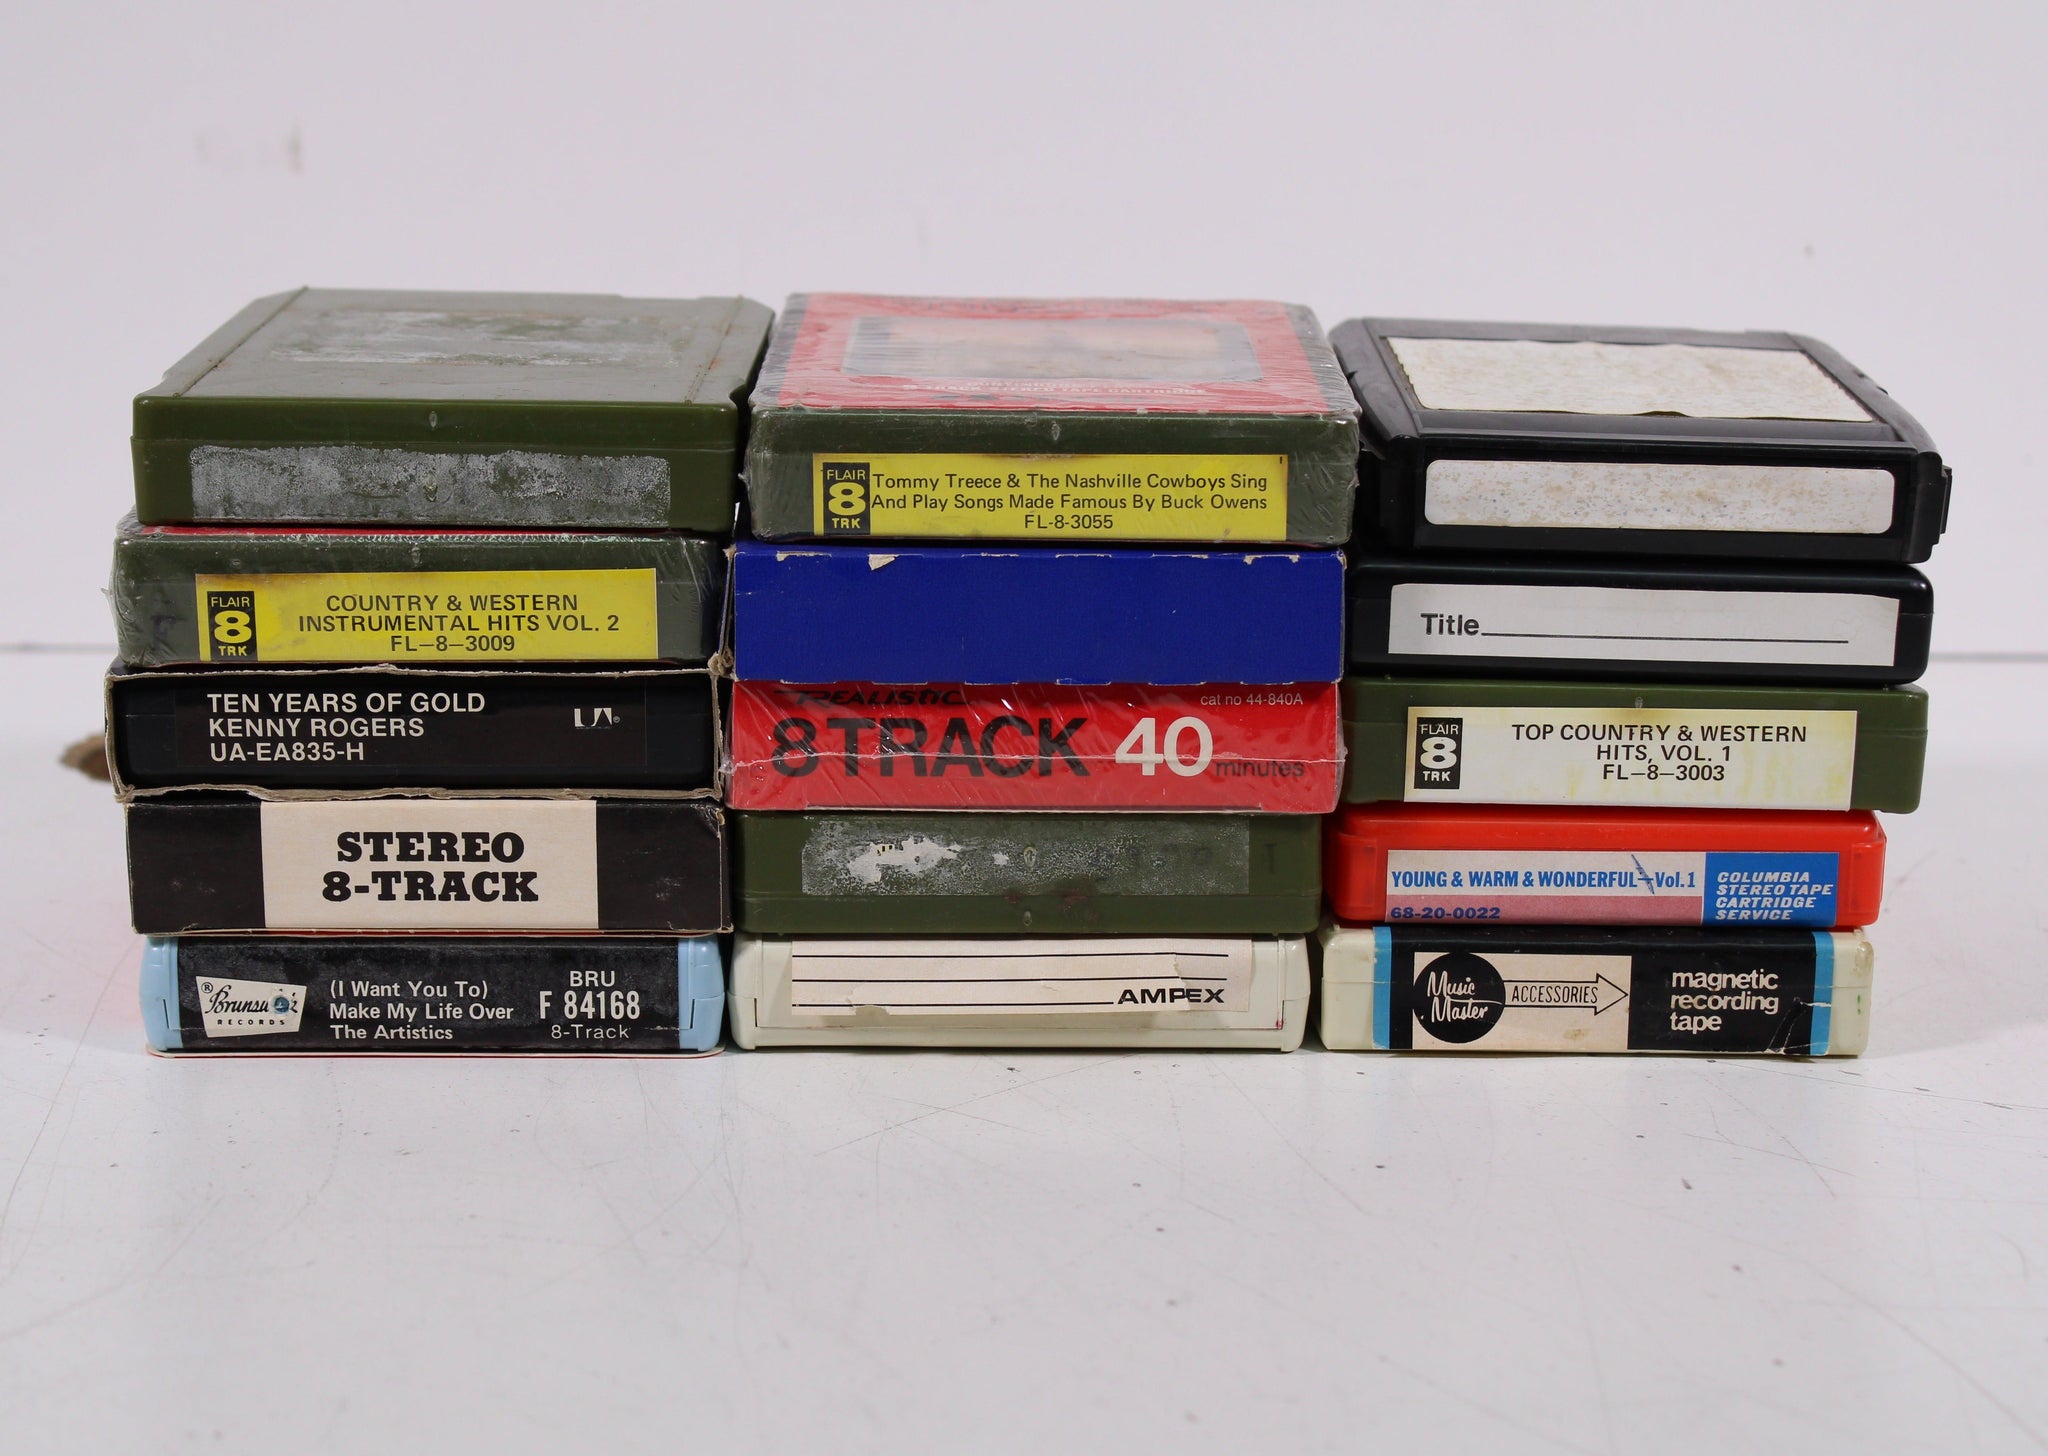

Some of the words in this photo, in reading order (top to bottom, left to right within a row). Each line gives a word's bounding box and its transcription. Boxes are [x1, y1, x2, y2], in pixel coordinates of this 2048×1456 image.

[826, 469, 866, 481] FLAIR
[873, 473, 940, 492] Tommy
[945, 473, 1002, 489] Treece
[1007, 473, 1021, 489] &
[1026, 473, 1060, 489] The
[1066, 473, 1141, 489] Nashville
[1147, 473, 1225, 492] Cowboys
[1231, 473, 1268, 492] Sing
[828, 483, 867, 514] 8
[872, 494, 908, 510] And
[913, 494, 948, 513] Play
[954, 494, 1004, 513] Songs
[1010, 494, 1055, 510] Made
[1061, 494, 1127, 510] Famous
[1133, 494, 1156, 513] By
[1162, 494, 1204, 510] Buck
[1210, 494, 1267, 510] Owens
[831, 517, 861, 529] TRK
[1024, 514, 1114, 530] FL-8-3055
[210, 596, 251, 608] FLAIR
[326, 594, 438, 612] COUNTRY
[446, 595, 462, 612] &
[469, 594, 578, 611] WESTERN
[214, 611, 252, 643] 8
[299, 615, 482, 632] INSTRUMENTAL
[488, 615, 540, 631] HITS
[545, 615, 601, 632] VOL.
[606, 615, 620, 631] 2
[1421, 613, 1480, 636] Title
[218, 646, 248, 657] TRK
[207, 694, 260, 713] TEN
[267, 694, 357, 713] YEARS
[365, 694, 402, 713] OF
[409, 694, 486, 713] GOLD
[1200, 694, 1224, 706] cat
[1225, 697, 1242, 706] no
[1246, 693, 1303, 706] 44-840A
[209, 719, 300, 737] KENNY
[309, 718, 424, 738] ROGERS
[1419, 724, 1459, 735] FLAIR
[1512, 725, 1554, 741] TOP
[1560, 724, 1671, 742] COUNTRY
[1678, 725, 1694, 742] &
[1700, 725, 1807, 742] WESTERN
[211, 742, 364, 762] UA-EA835-H
[772, 717, 819, 777] 8
[827, 715, 1089, 777] TRACK
[1115, 716, 1214, 777] 40
[1418, 737, 1458, 769] 8
[1597, 744, 1655, 764] HITS,
[1661, 745, 1712, 761] VOL.
[1722, 746, 1731, 761] 1
[1215, 758, 1305, 778] minutes
[1422, 771, 1452, 782] TRK
[337, 832, 525, 863] STEREO
[322, 872, 539, 902] 8-TRACK
[1392, 871, 1447, 888] YOUNG
[1451, 871, 1463, 888] &
[1468, 871, 1519, 888] WARM
[1522, 871, 1534, 888] &
[1717, 872, 1810, 883] COLUMBIA
[1716, 884, 1785, 895] STEREO
[1789, 884, 1834, 895] TAPE
[1715, 897, 1817, 908] CARTRIDGE
[1390, 906, 1501, 919] 68-20-0022
[1715, 910, 1794, 920] SERVICE
[570, 971, 615, 987] BRU
[1427, 970, 1476, 997] Music
[1671, 971, 1779, 992] magnetic
[330, 980, 342, 999] (I
[350, 981, 401, 998] Want
[408, 981, 447, 998] You
[453, 980, 488, 999] To)
[1117, 988, 1225, 1004] AMPEX
[1511, 986, 1599, 1004] ACCESSORIES
[330, 1003, 380, 1020] Make
[387, 1003, 418, 1024] My
[425, 1003, 463, 1020] Life
[469, 1004, 513, 1020] Over
[539, 991, 553, 1019] F
[564, 991, 641, 1020] 84168
[1431, 997, 1489, 1023] Master
[1671, 992, 1779, 1016] recording
[330, 1025, 366, 1039] The
[371, 1025, 453, 1040] Artistics
[551, 1025, 629, 1039] 8-Track
[1670, 1013, 1722, 1034] tape
